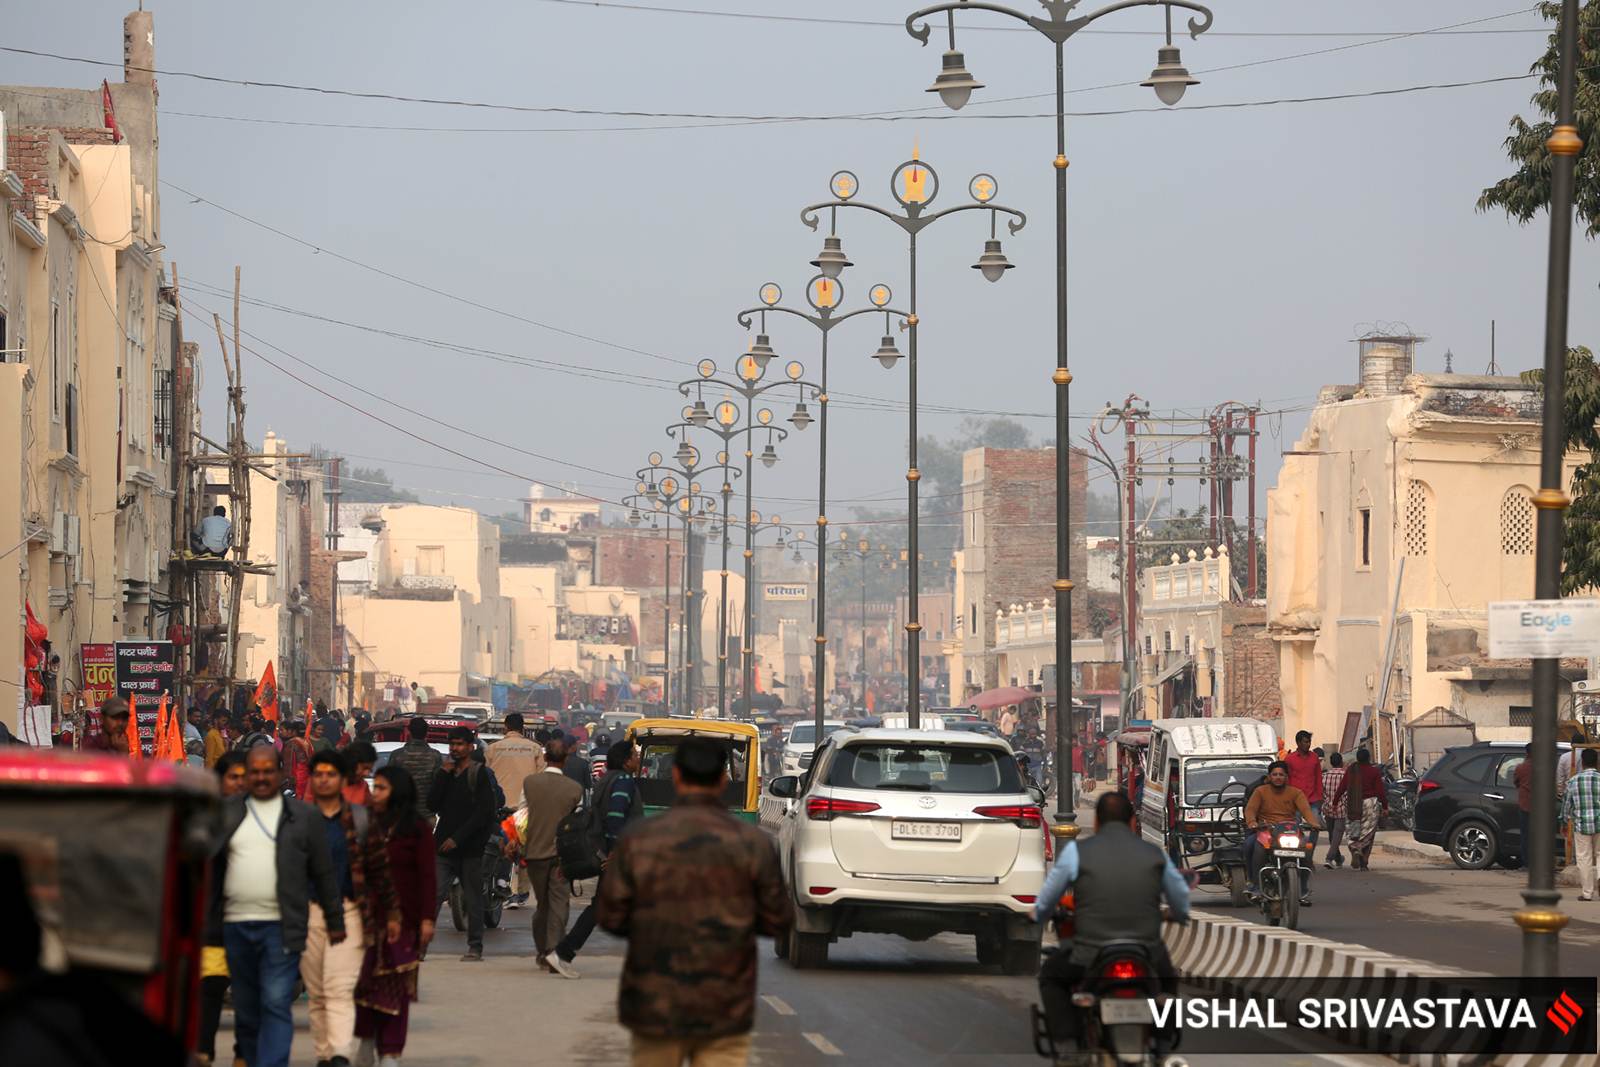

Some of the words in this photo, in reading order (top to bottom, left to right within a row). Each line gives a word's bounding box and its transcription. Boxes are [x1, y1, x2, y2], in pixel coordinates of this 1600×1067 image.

[1521, 612, 1572, 632] Eagle
[119, 648, 135, 657] मटर
[121, 681, 138, 689] दाल
[935, 825, 959, 837] 3700
